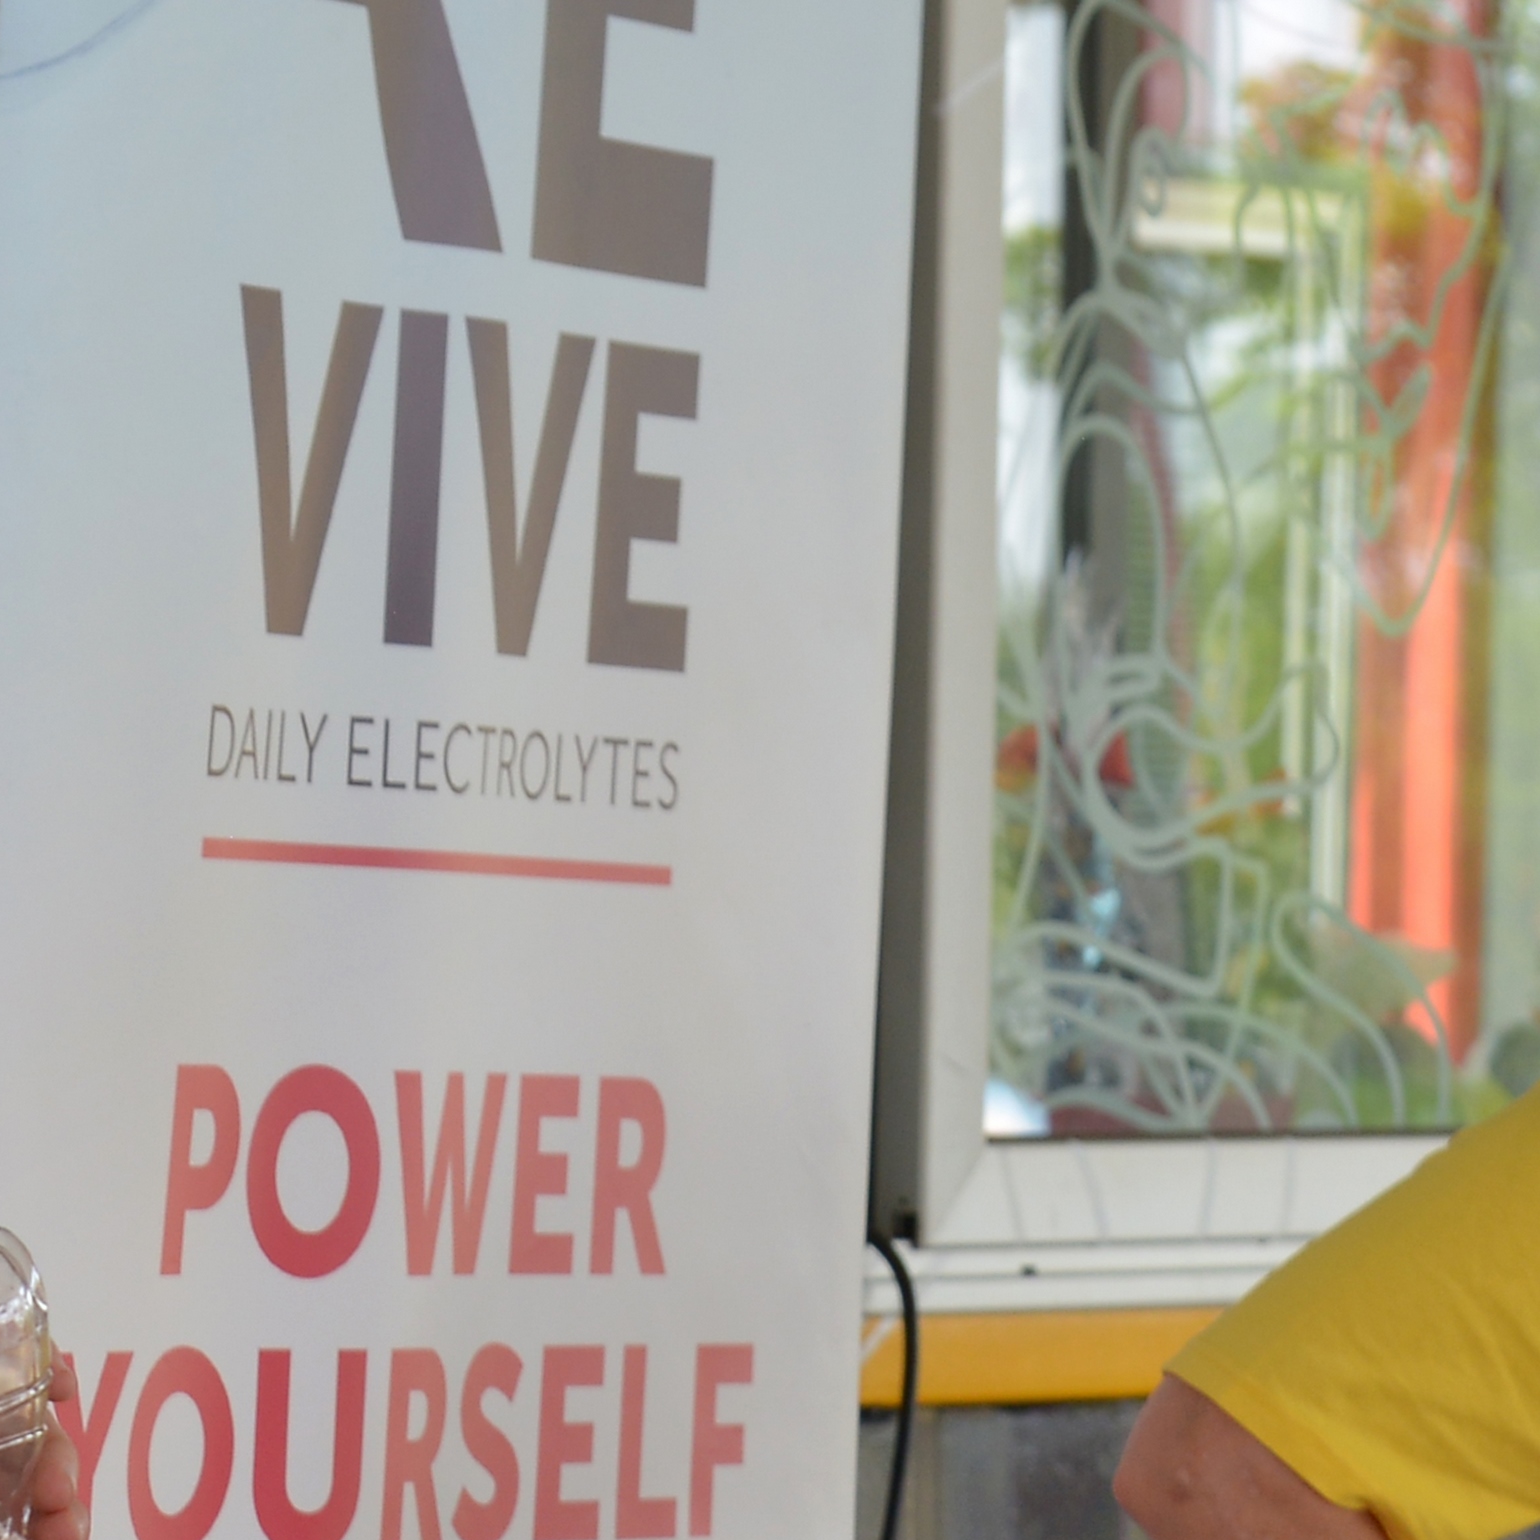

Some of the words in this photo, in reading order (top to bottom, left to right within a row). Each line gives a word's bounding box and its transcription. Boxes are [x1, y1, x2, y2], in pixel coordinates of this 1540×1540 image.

[239, 283, 701, 673] VIVE
[206, 704, 328, 784] DAILY
[346, 716, 680, 811] ELECTROLYTES
[159, 1064, 667, 1278] POWER
